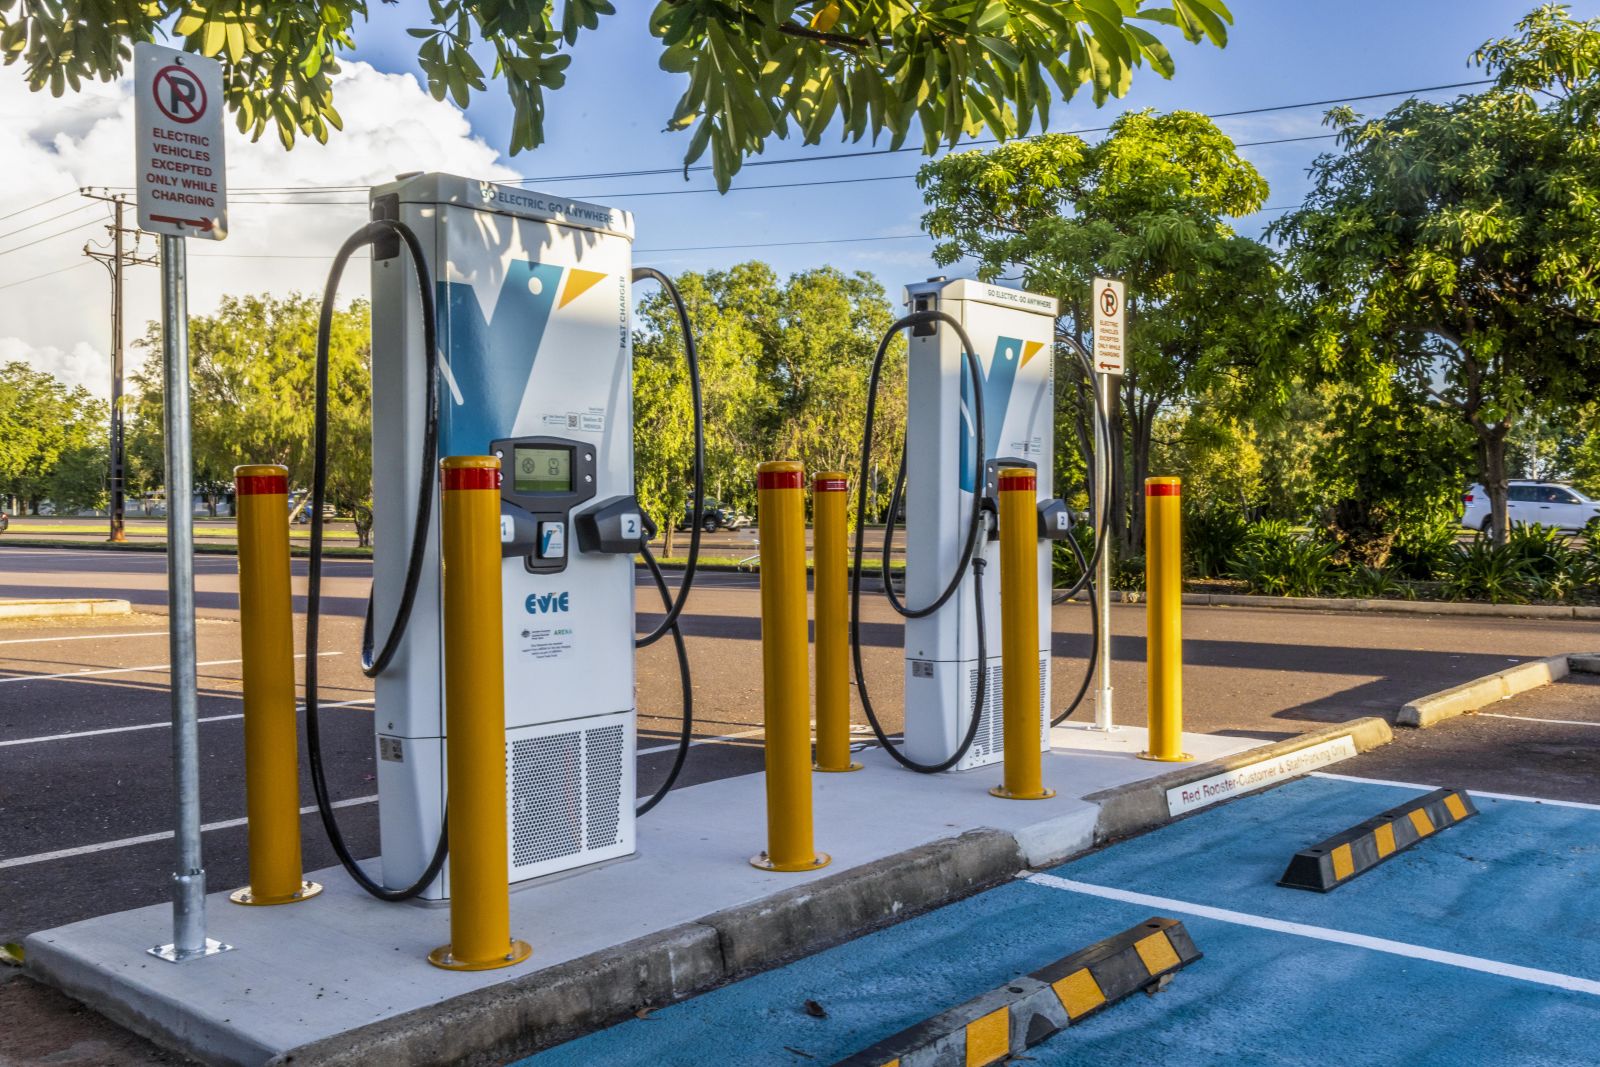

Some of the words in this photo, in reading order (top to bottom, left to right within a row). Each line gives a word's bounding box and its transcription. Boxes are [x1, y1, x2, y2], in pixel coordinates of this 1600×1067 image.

[153, 127, 210, 147] ELECTRIC
[153, 142, 210, 162] VEHICLES
[151, 158, 212, 177] EXCEPTED
[146, 173, 178, 187] ONLY
[181, 178, 218, 193] WHILE
[151, 189, 215, 207] CHARGING
[481, 188, 496, 201] GO
[498, 191, 546, 211] ELECTRIC.
[548, 202, 563, 214] GO
[565, 206, 614, 224] ANYWHERE
[627, 519, 636, 533] 2
[1060, 515, 1065, 526] 2
[525, 591, 569, 614] EVIE
[1182, 787, 1201, 804] Red
